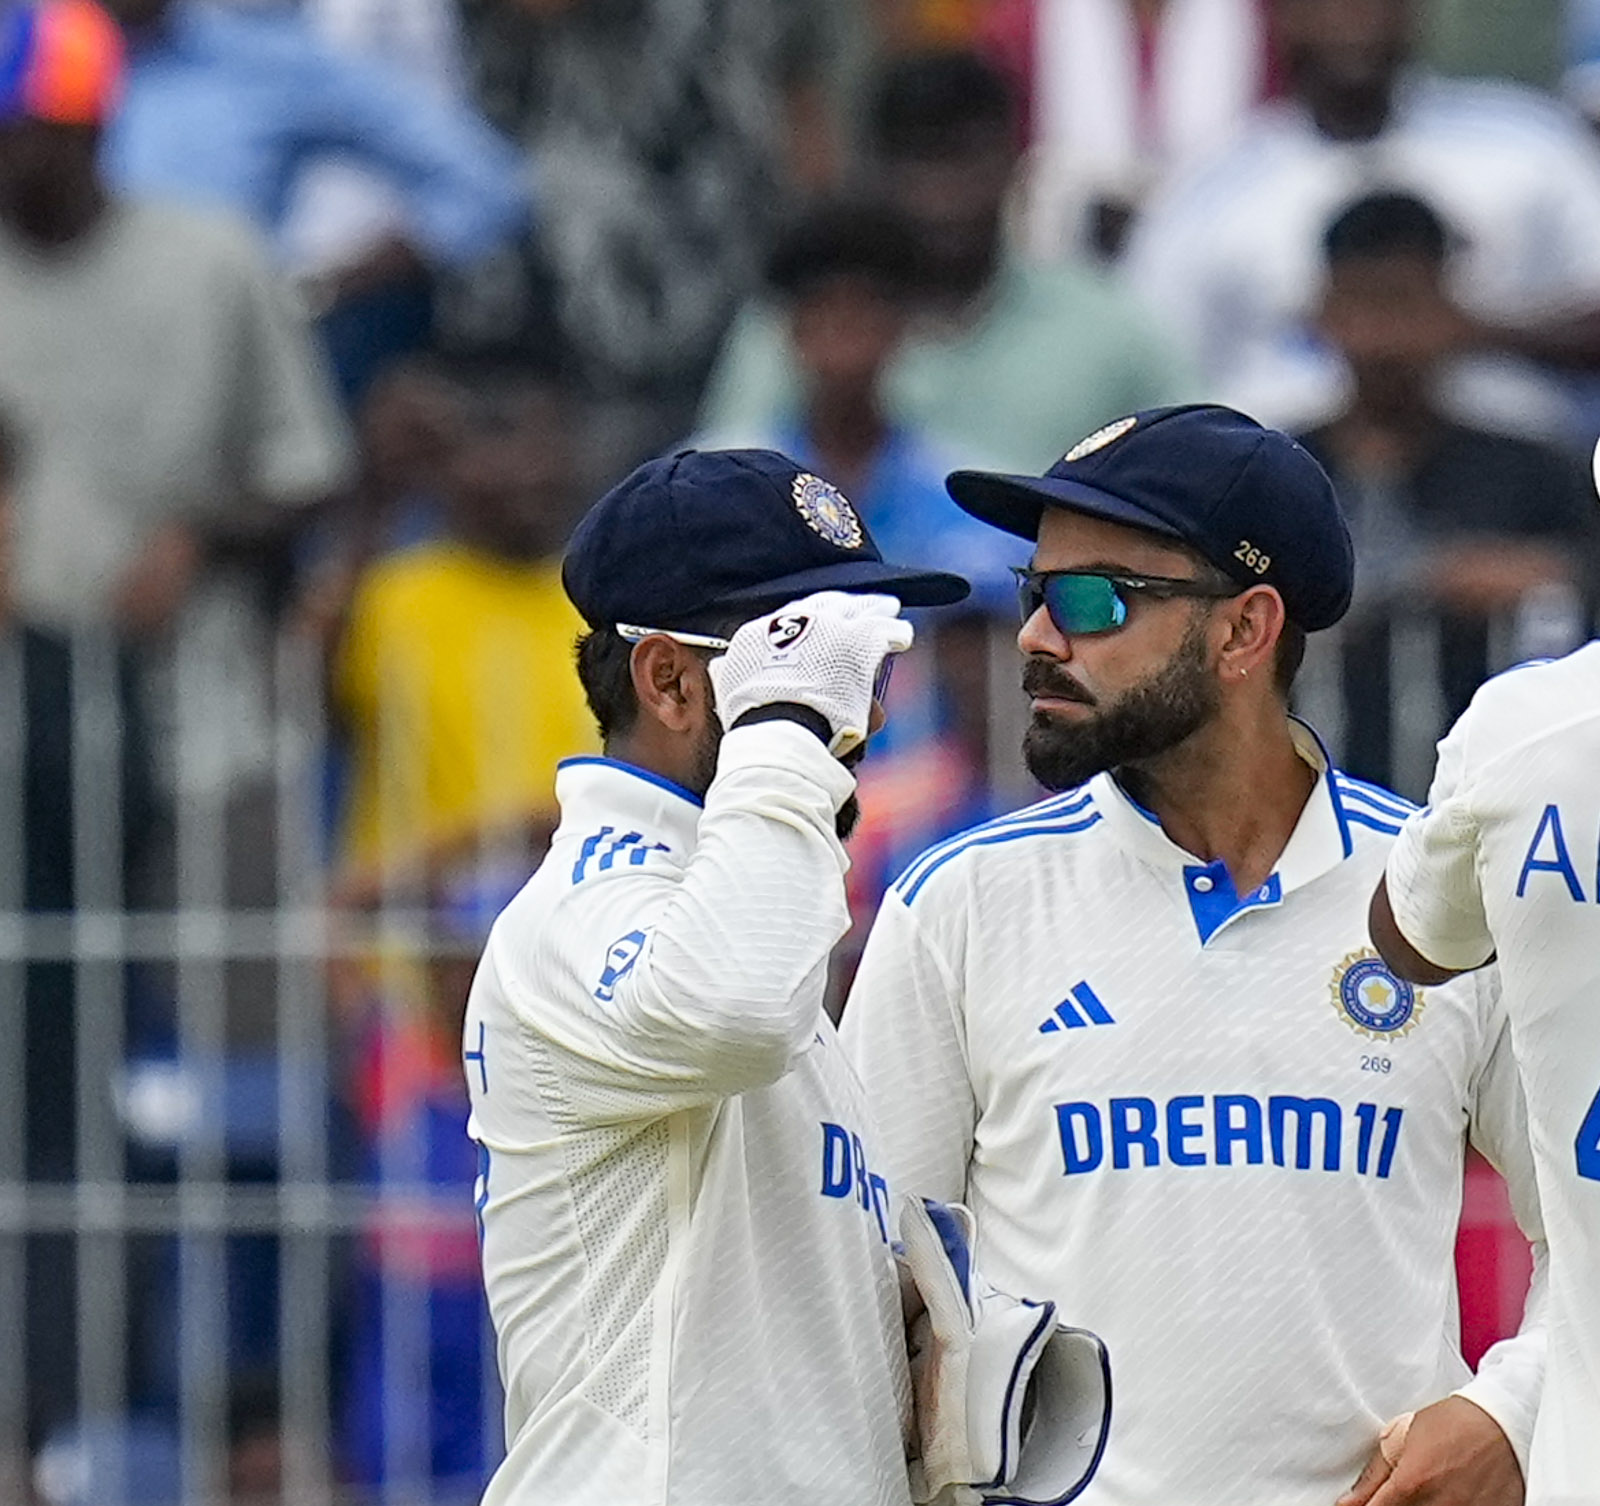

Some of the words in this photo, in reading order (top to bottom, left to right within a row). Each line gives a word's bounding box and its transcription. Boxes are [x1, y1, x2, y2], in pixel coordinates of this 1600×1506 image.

[1234, 540, 1271, 576] 269
[1360, 1055, 1392, 1074] 269
[1053, 1093, 1404, 1179] DREAM11
